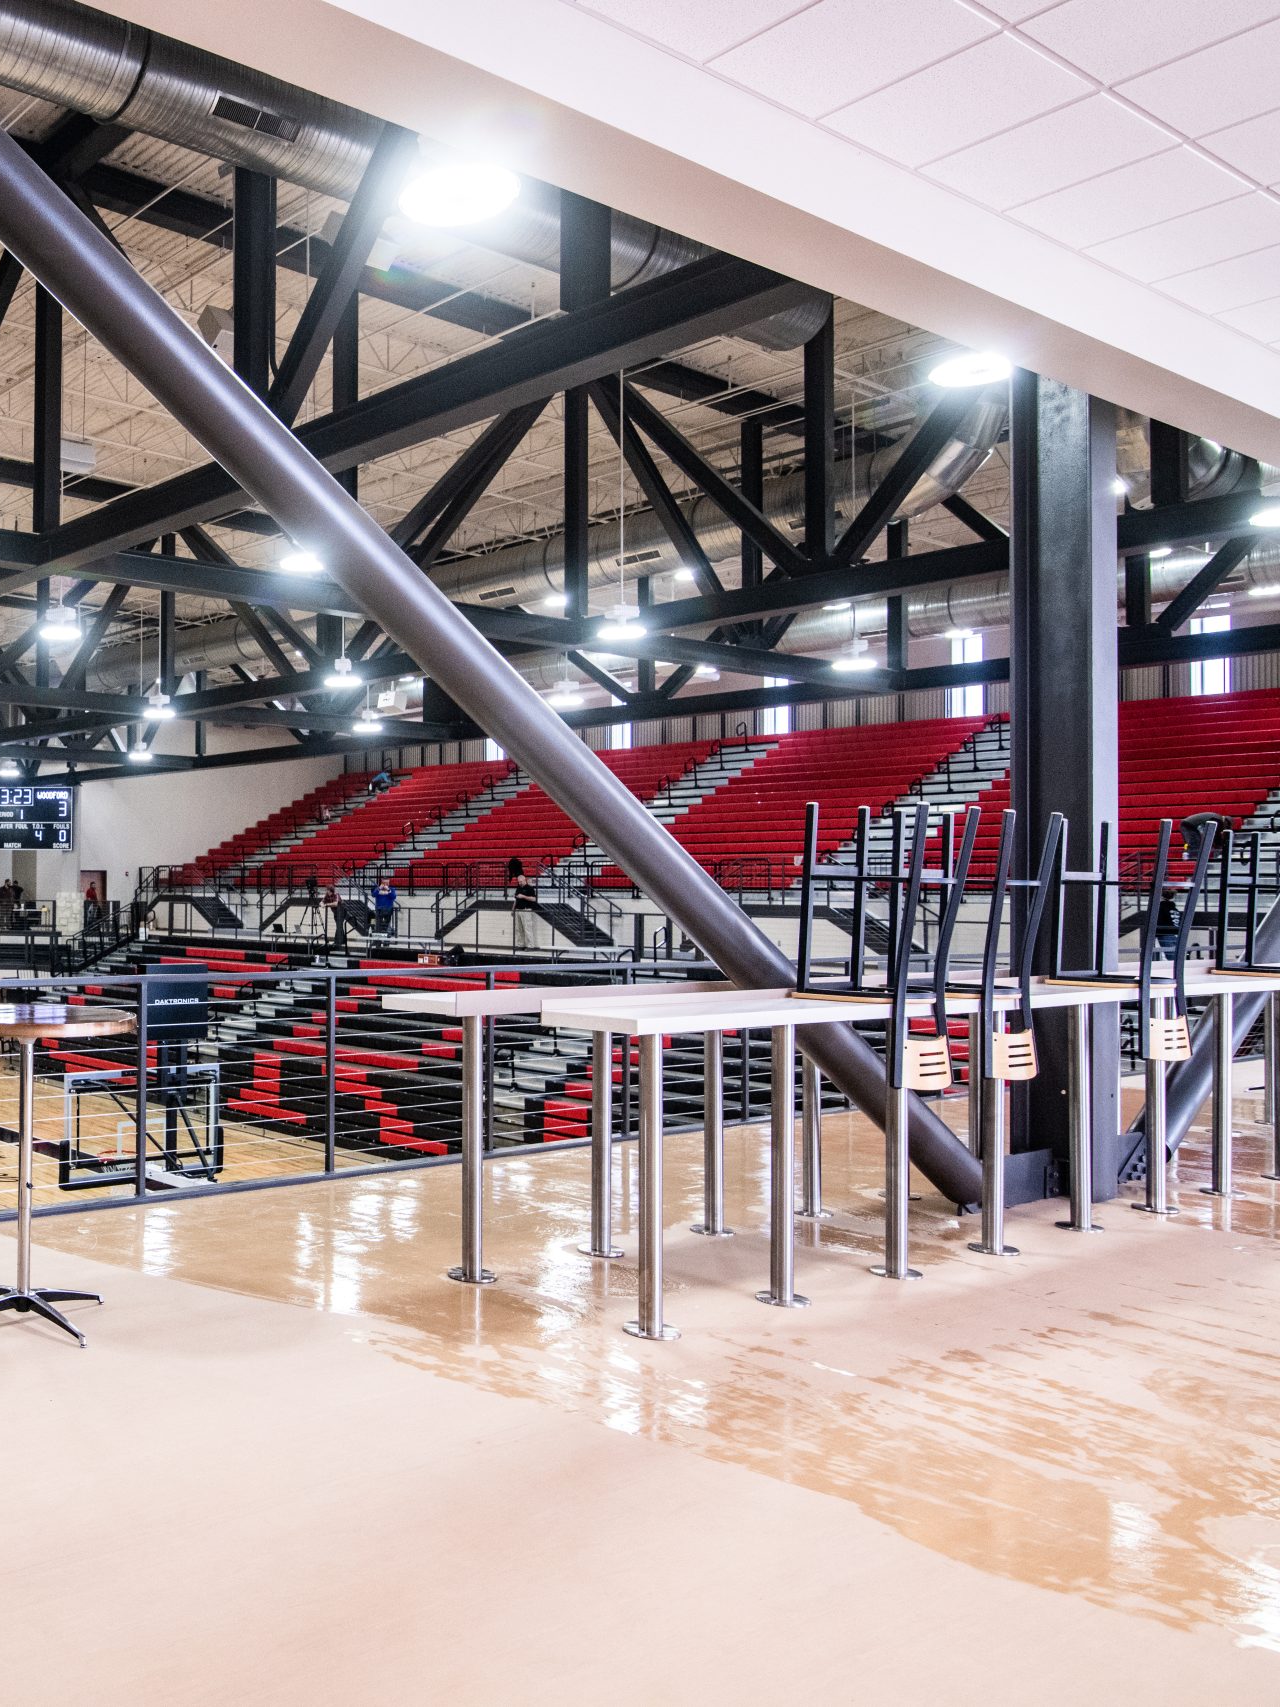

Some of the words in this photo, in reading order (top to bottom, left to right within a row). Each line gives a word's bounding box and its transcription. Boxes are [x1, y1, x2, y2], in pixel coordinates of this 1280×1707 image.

[37, 791, 69, 800] WOODFORD
[58, 801, 67, 817] 3
[34, 830, 43, 841] 4
[58, 830, 67, 842] 0
